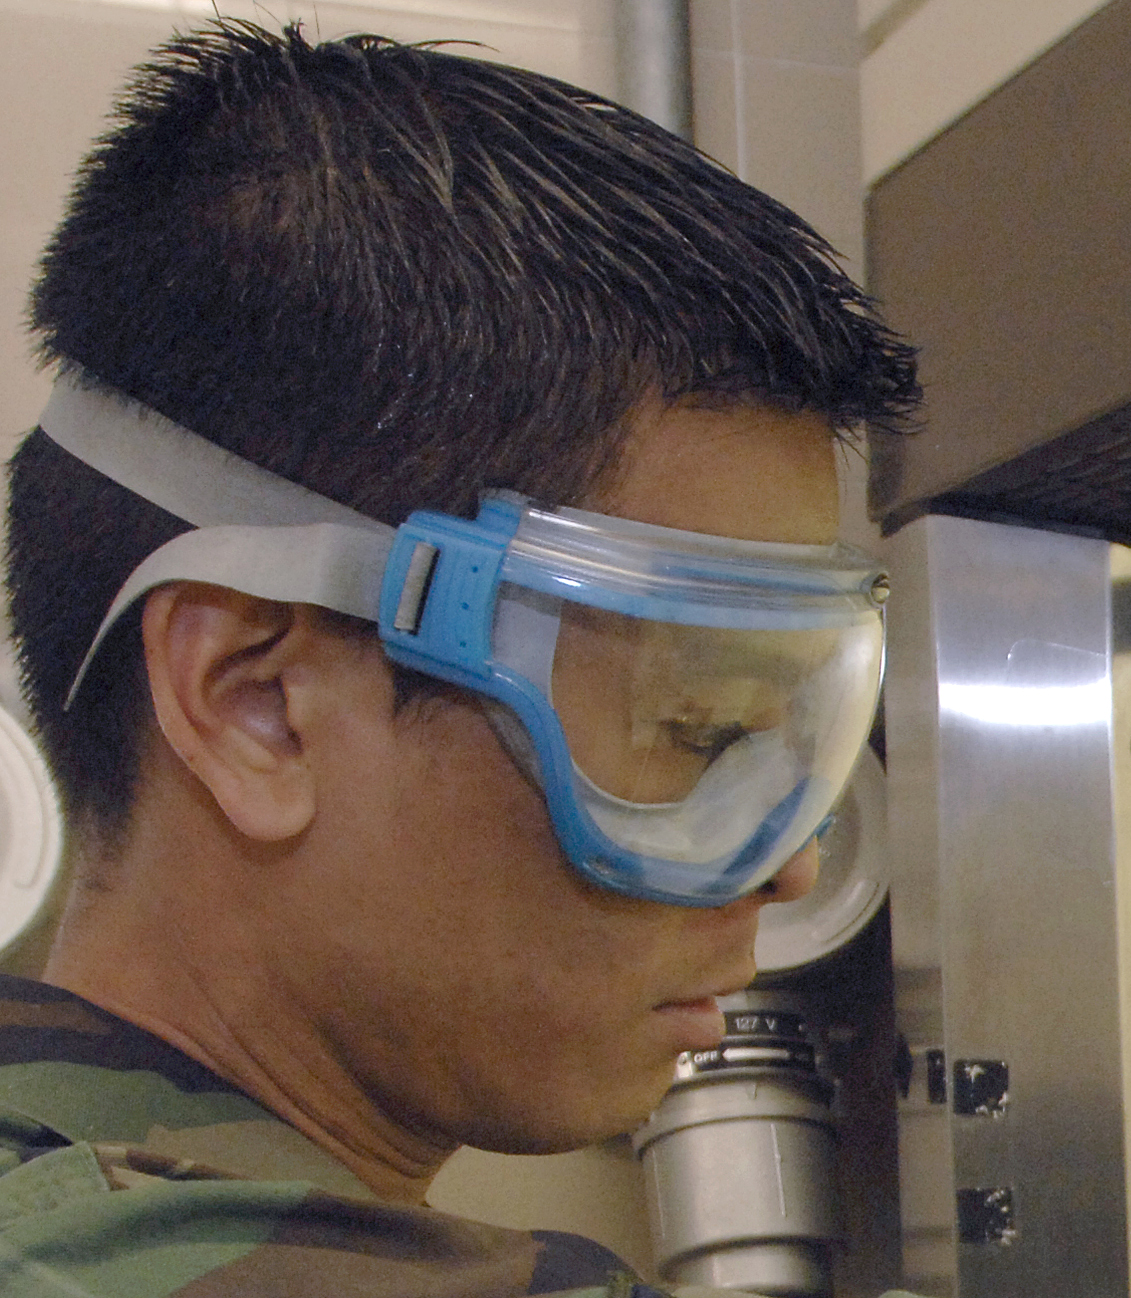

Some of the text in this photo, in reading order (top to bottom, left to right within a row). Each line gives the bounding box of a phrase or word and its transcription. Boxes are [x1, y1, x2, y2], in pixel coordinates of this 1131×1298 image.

[735, 1017, 777, 1032] 127 V
[694, 1049, 719, 1063] OFF
